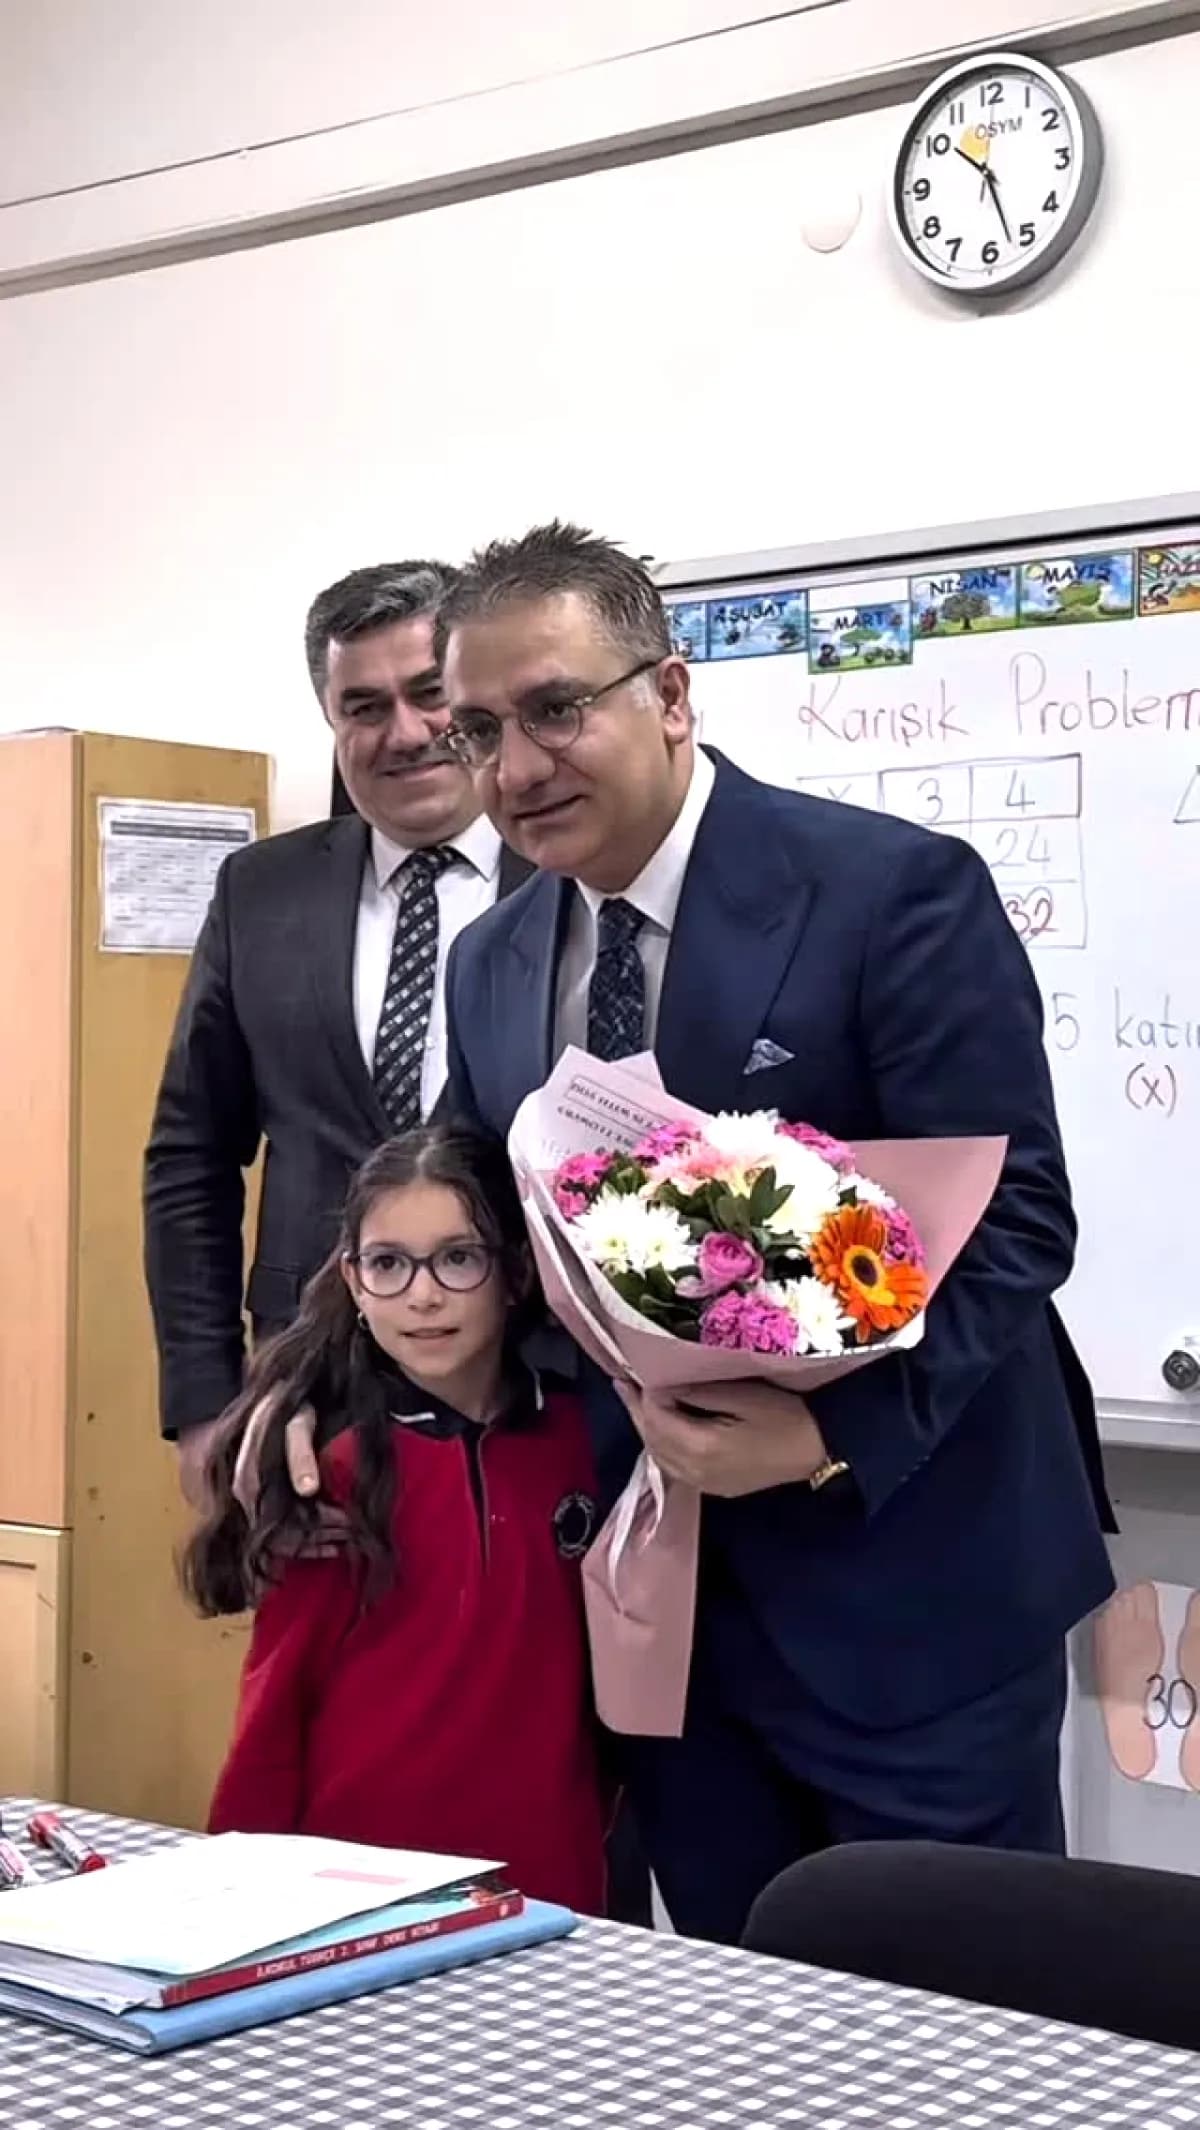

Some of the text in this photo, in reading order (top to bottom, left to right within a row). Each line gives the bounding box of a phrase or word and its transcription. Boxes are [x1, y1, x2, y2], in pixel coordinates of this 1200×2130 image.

[980, 81, 1004, 107] 12
[1024, 86, 1031, 108] 1
[950, 102, 965, 125] 11
[1040, 108, 1060, 131] 2
[926, 133, 951, 158] 10
[1054, 147, 1070, 171] 3
[913, 177, 931, 201] 9
[1041, 190, 1060, 213] 4
[922, 215, 941, 238] 8
[1018, 222, 1036, 247] 5
[945, 236, 963, 262] 7
[980, 241, 1000, 265] 6
[834, 611, 885, 631] MART
[799, 675, 970, 748] Karışık
[917, 769, 1036, 824] 3 4
[990, 824, 1051, 876] 24
[1052, 992, 1080, 1051] 5
[1142, 1673, 1197, 1731] 30
